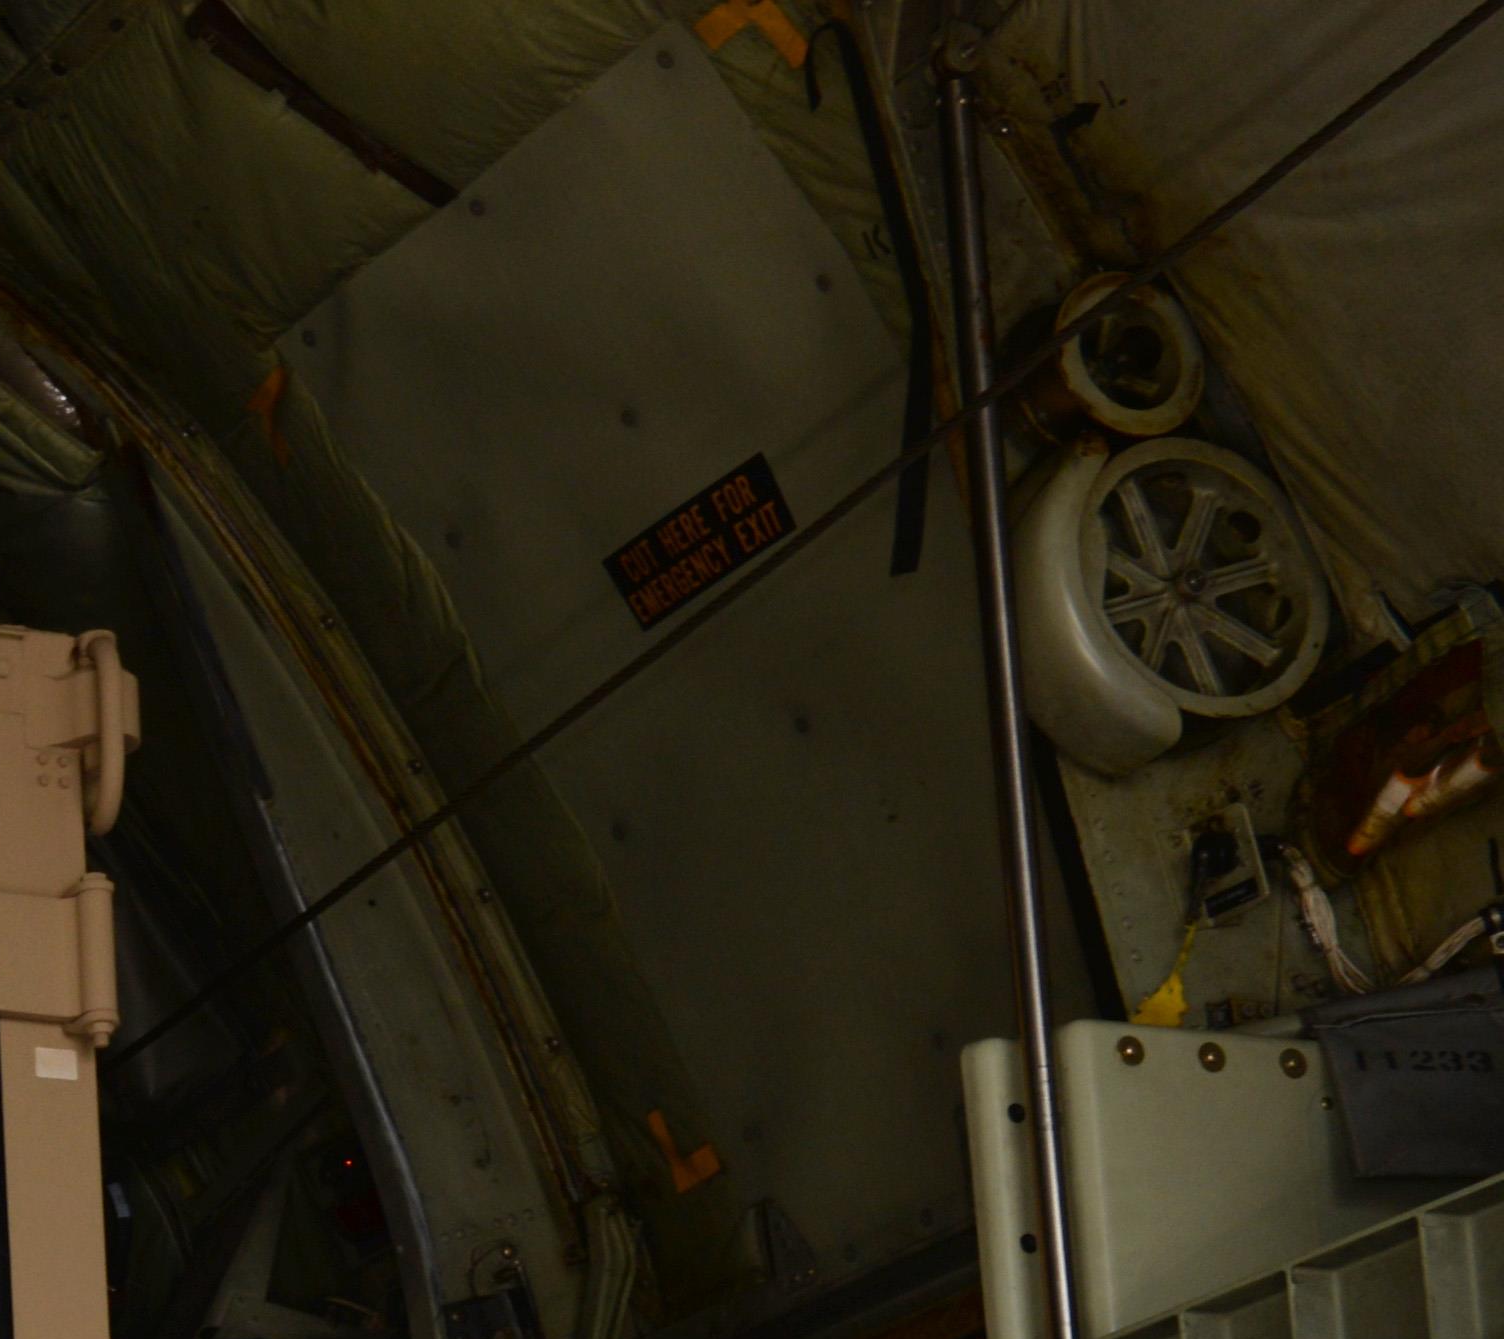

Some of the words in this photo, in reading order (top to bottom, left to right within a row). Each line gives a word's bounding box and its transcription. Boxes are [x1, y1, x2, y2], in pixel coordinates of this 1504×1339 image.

[617, 537, 660, 584] CUT
[656, 503, 712, 560] HERE
[709, 472, 758, 525] FOR
[626, 533, 734, 625] EMERGENCY
[731, 499, 785, 556] EXIT
